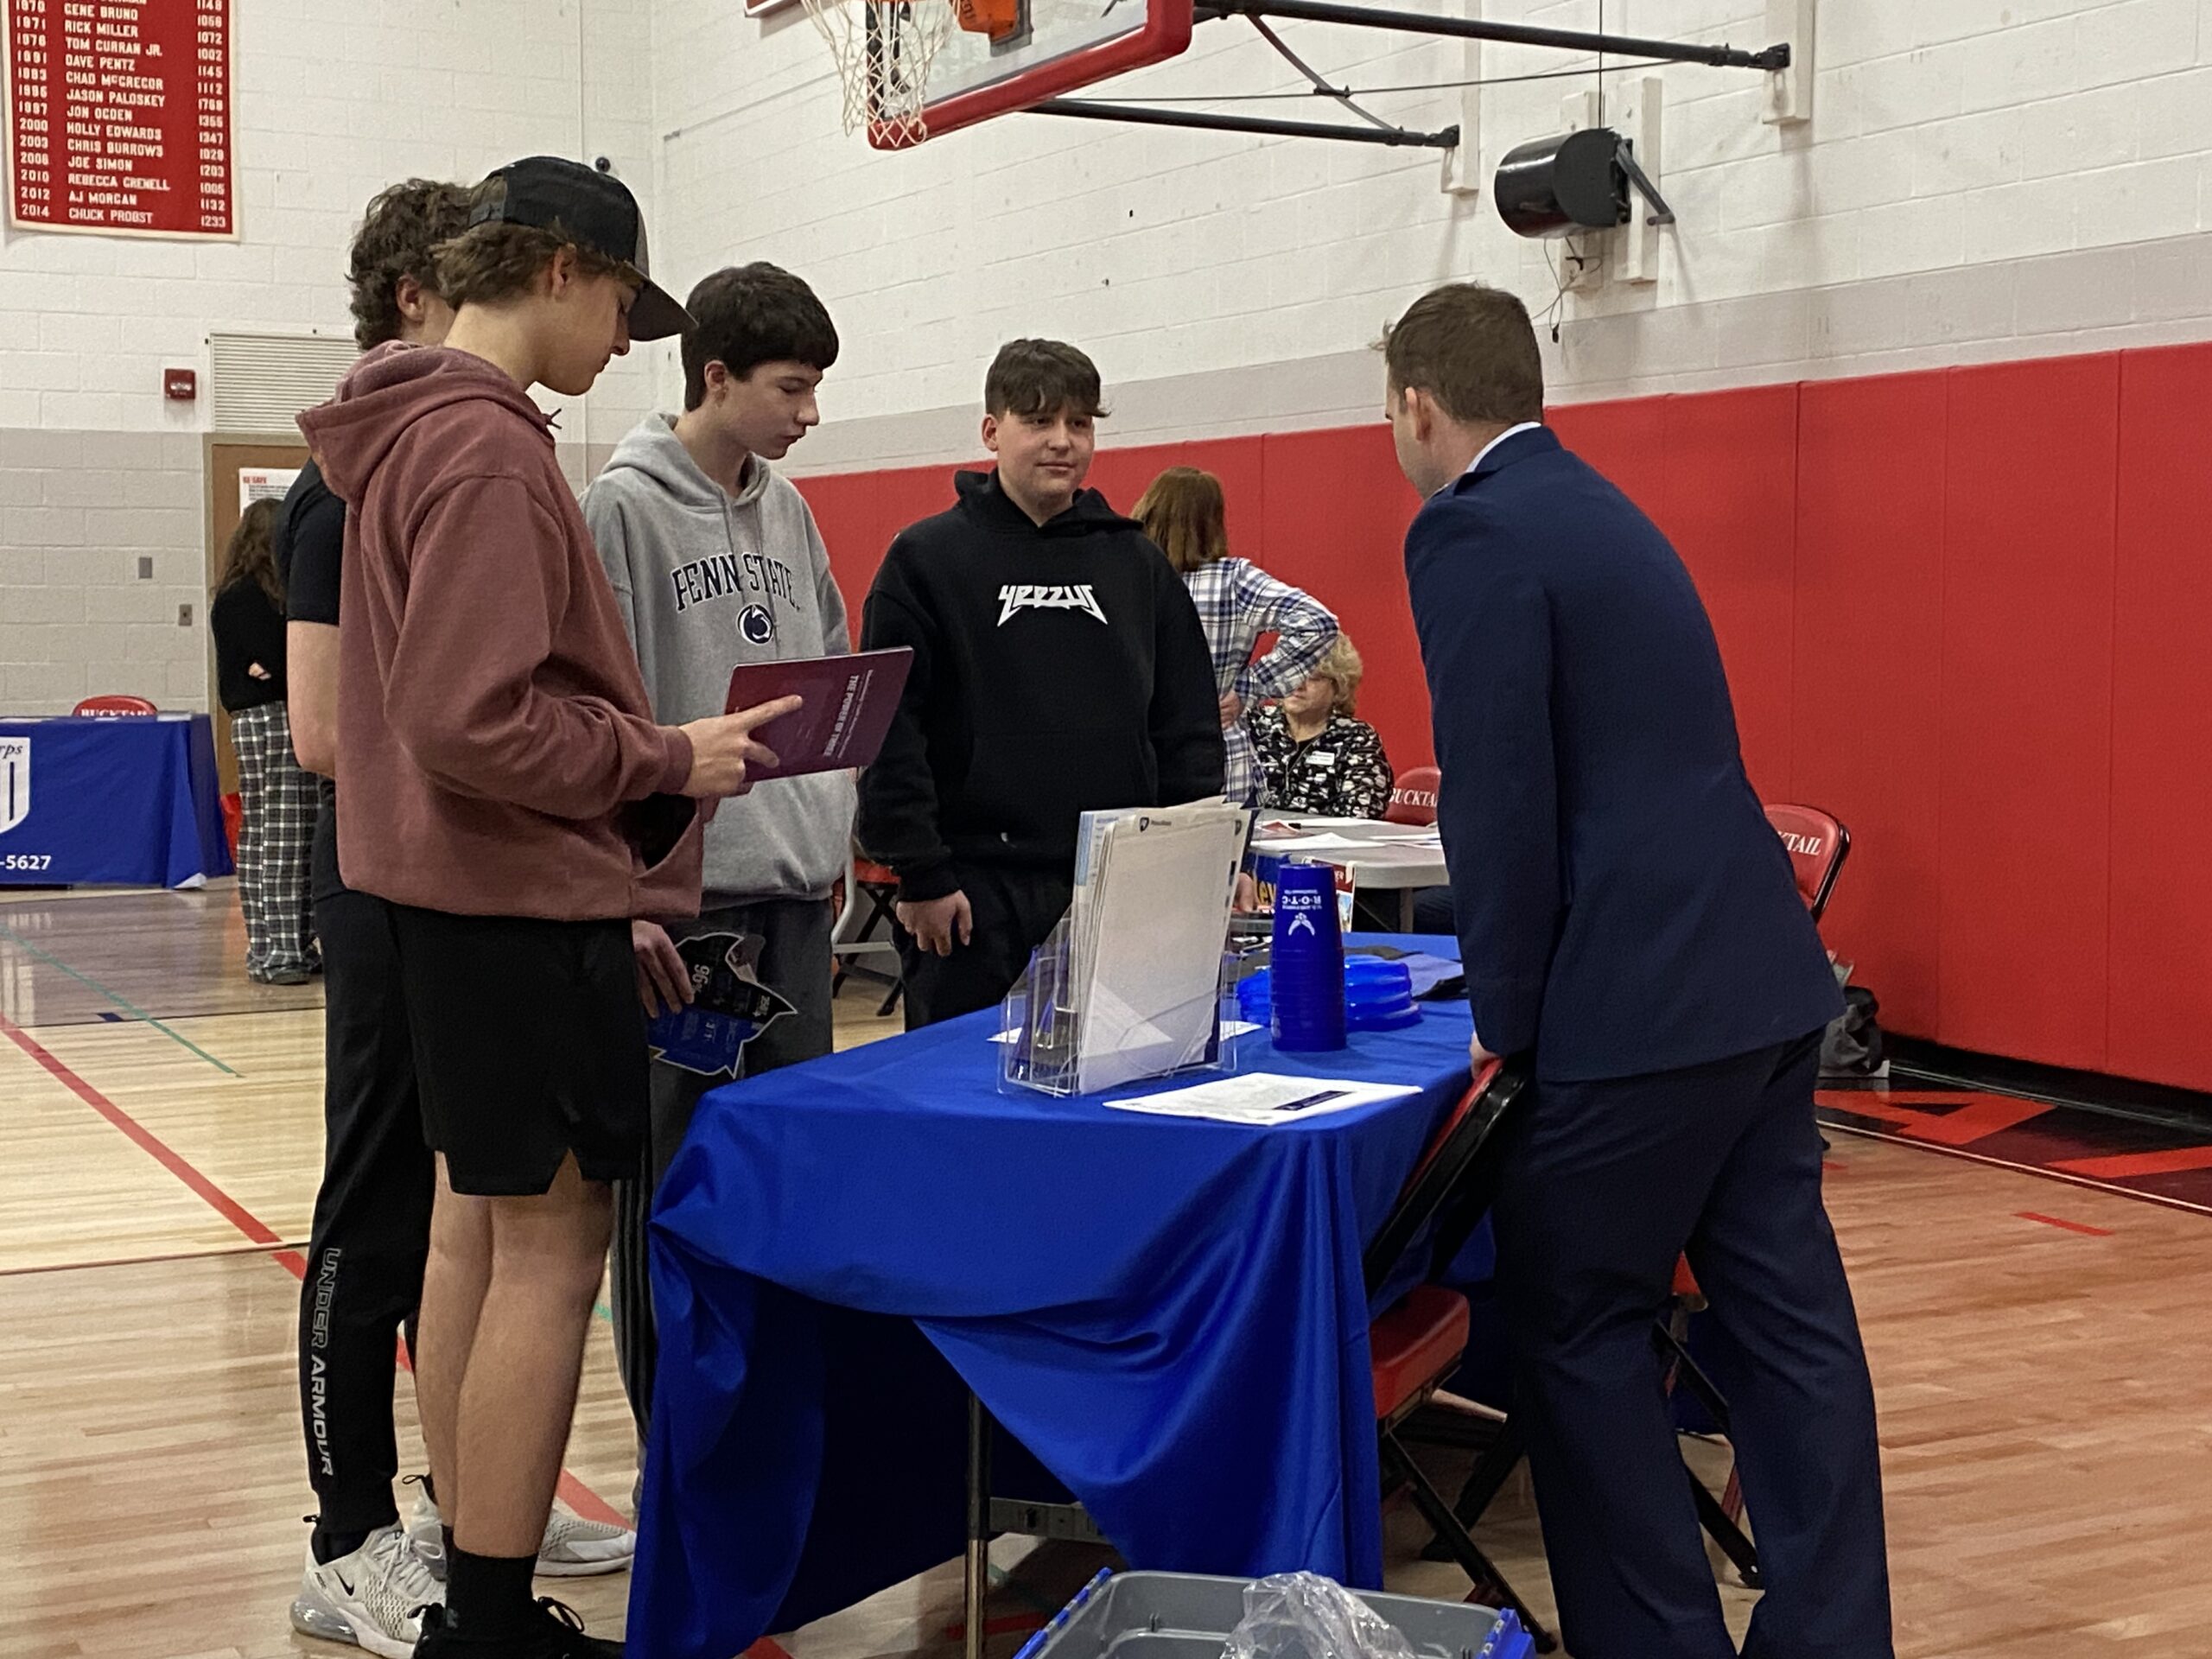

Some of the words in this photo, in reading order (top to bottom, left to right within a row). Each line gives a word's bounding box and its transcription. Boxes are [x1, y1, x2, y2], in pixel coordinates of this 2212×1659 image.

[100, 6, 138, 21] BRUNO
[65, 20, 91, 34] RICK
[97, 22, 138, 37] MILLER
[66, 36, 90, 50] TOM
[96, 39, 141, 55] CURRAN
[145, 43, 162, 57] JR.
[65, 54, 94, 68] DAVE
[99, 57, 135, 71] PENTZ
[66, 71, 96, 85] CHAD
[197, 82, 223, 95] 1112
[67, 89, 104, 103] JASON
[109, 91, 165, 107] PALOSKEY
[67, 105, 89, 118] JON
[94, 107, 132, 122] OGDEN
[20, 118, 48, 131] 2000
[67, 122, 100, 136] HOLLY
[106, 124, 162, 141] EDWARDS
[20, 135, 48, 149] 2003
[67, 138, 101, 153] CHRIS
[107, 142, 163, 157] BURROWS
[68, 156, 90, 169] JOE
[96, 157, 133, 172] SIMON
[21, 168, 49, 183] 2010
[68, 173, 118, 188] REBECCA
[21, 186, 50, 200] 2012
[69, 190, 84, 203] AJ
[88, 191, 137, 206] MORGAN
[200, 198, 226, 212] 1132
[22, 203, 50, 217] 2014
[69, 207, 105, 221] CHUCK
[111, 209, 153, 224] PROBST
[671, 552, 742, 612] PENN
[743, 552, 797, 608] STATE
[311, 1247, 341, 1349] UNDER
[310, 1353, 334, 1477] ARMOUR
